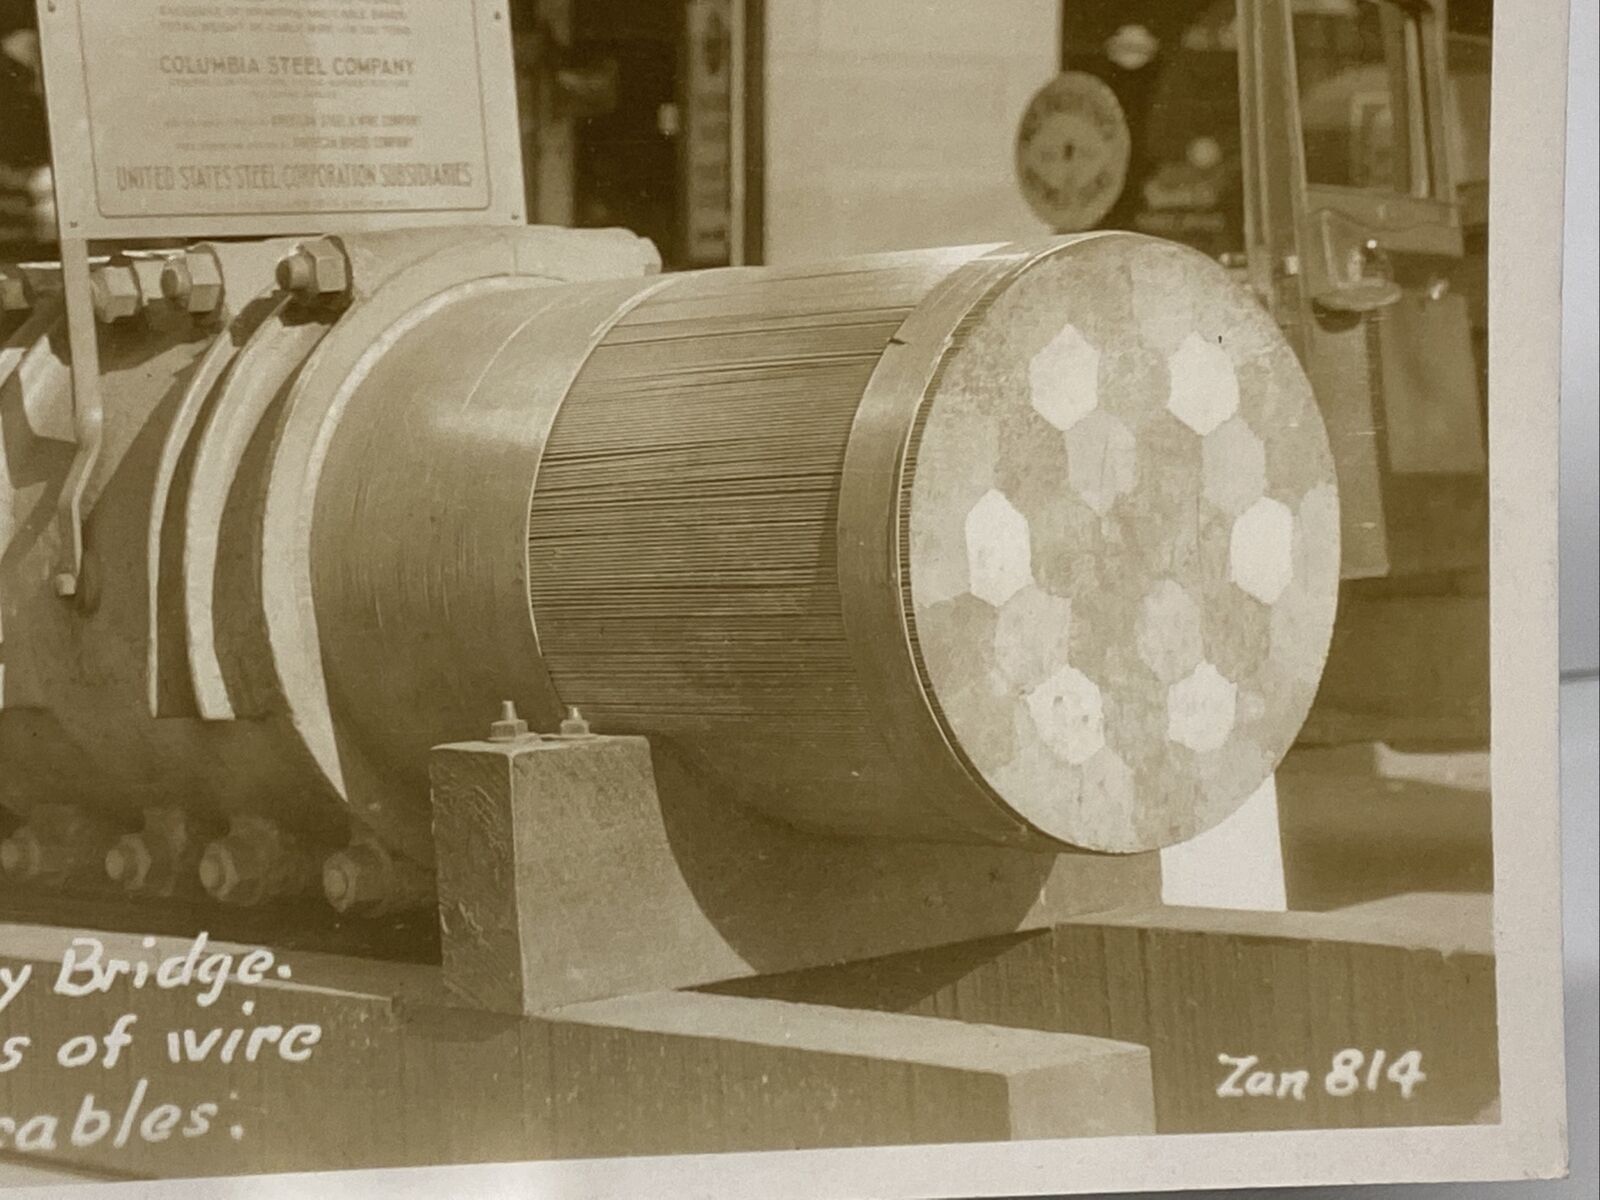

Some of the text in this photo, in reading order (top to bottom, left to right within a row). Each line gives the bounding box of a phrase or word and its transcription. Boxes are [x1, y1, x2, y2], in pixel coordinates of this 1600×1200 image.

[159, 55, 415, 76] COLUMBIA STEEL COMPANY
[116, 161, 473, 191] UNITED STATES STEEL CORPORATION SUBSIDIARIES
[54, 931, 292, 1007] Bridge.
[57, 1014, 137, 1069] of
[167, 1000, 322, 1064] wire
[1216, 1048, 1426, 1100] Zan 814
